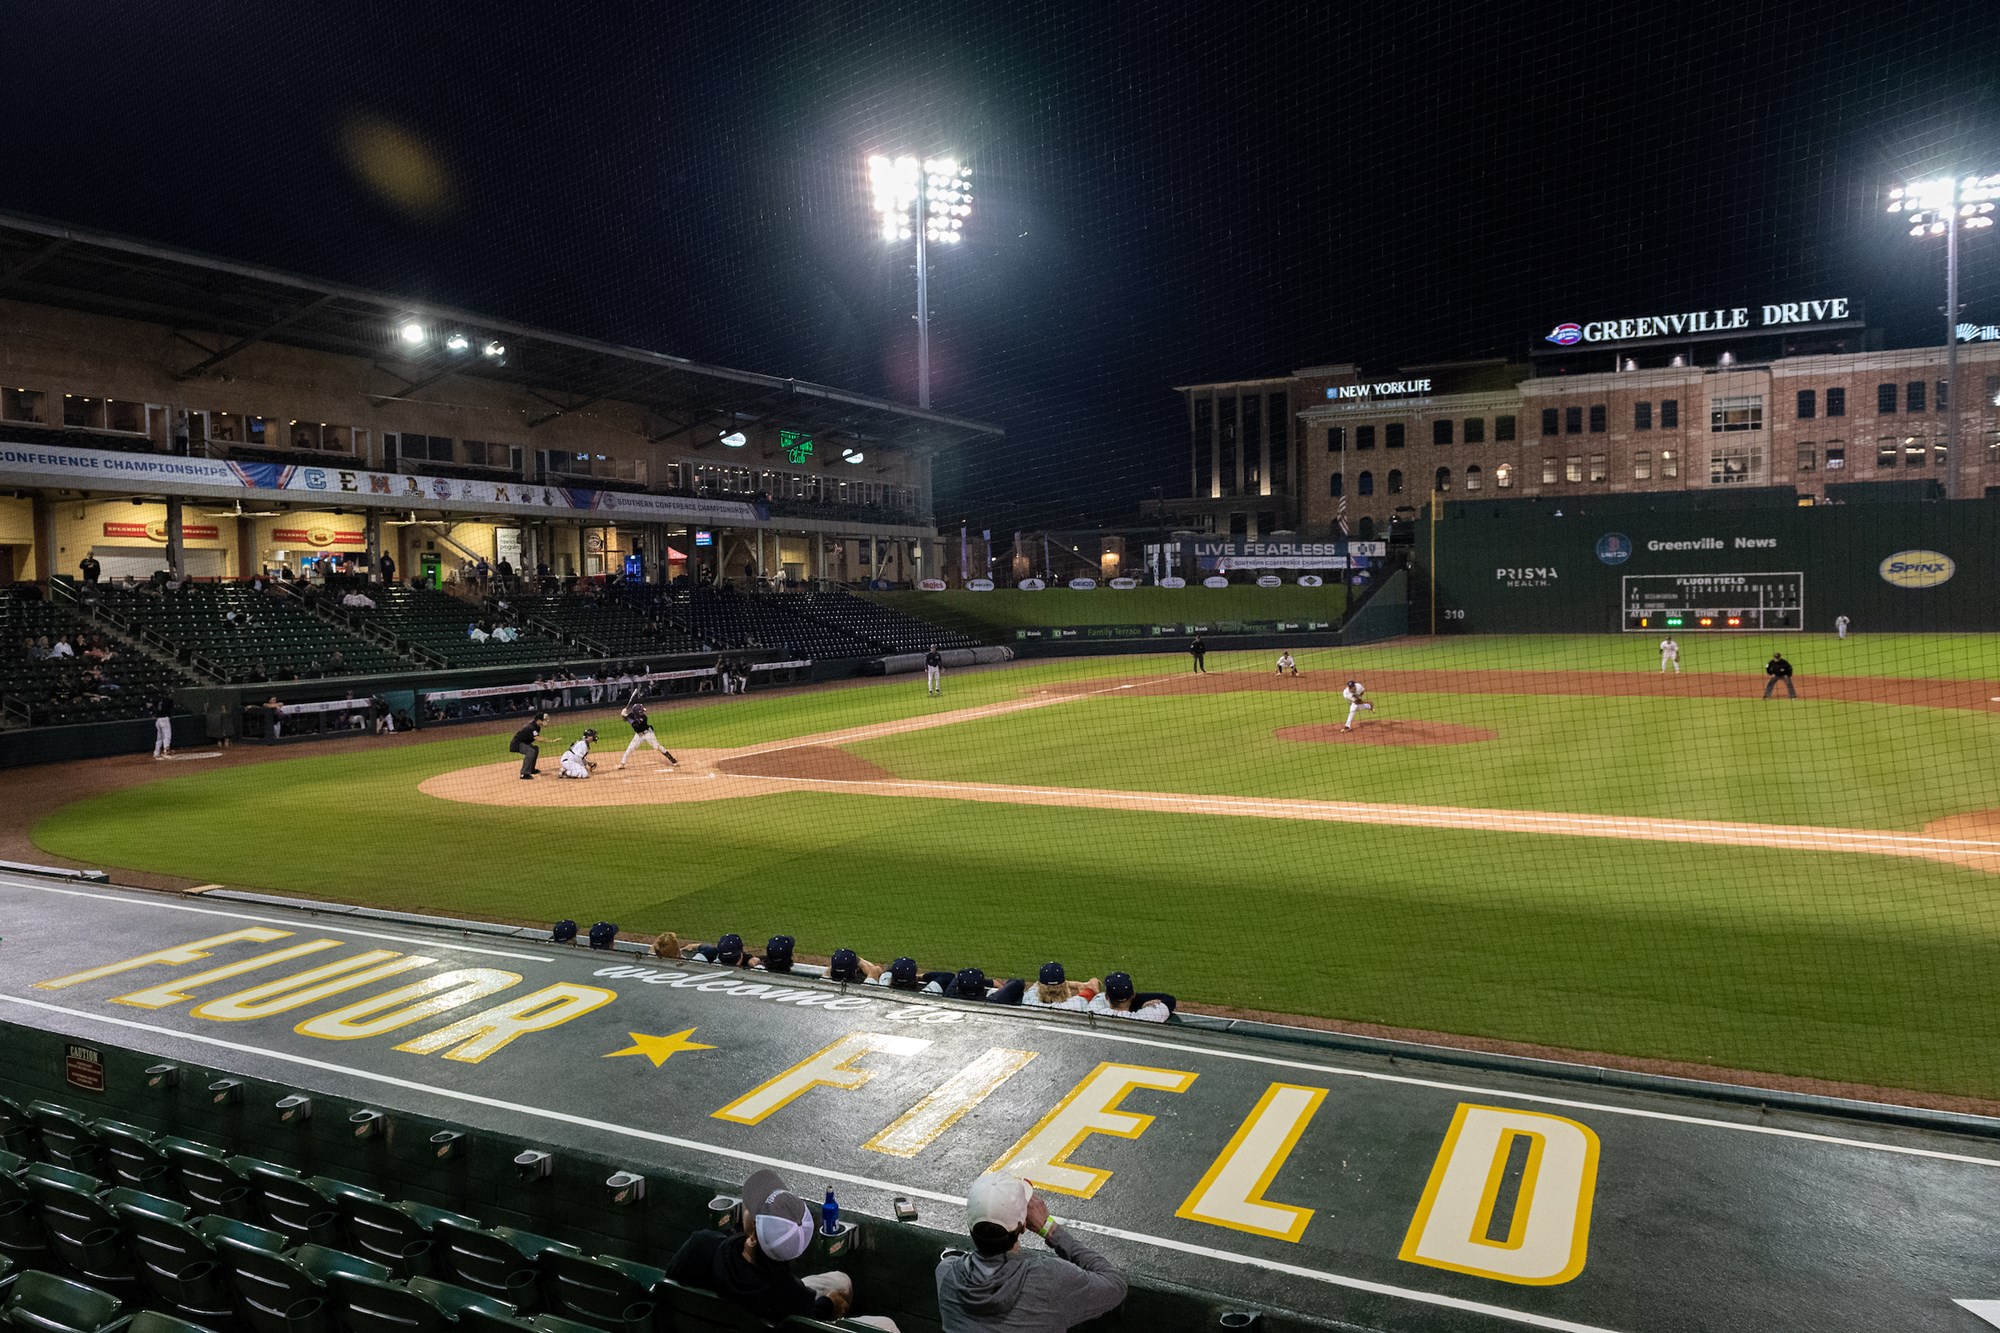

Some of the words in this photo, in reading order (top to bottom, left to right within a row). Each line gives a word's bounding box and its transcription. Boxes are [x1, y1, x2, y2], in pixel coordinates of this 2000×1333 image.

[1583, 308, 1749, 342] GREENVILLE
[1762, 298, 1849, 326] DRIVE
[1339, 385, 1370, 398] NEW
[1373, 382, 1406, 395] YORK
[1407, 379, 1431, 392] LIFE
[104, 459, 227, 477] CHAMPIONSHIPS
[617, 498, 653, 508] SOUTHERN
[655, 501, 696, 511] CONFERENCE
[697, 503, 750, 514] CHAMPIONSHIPS
[1195, 543, 1236, 556] LIVE
[1243, 543, 1336, 556] FEARLESS
[1648, 537, 1724, 551] Greenville
[1735, 536, 1778, 549] News
[1497, 567, 1559, 580] PRISMA
[1676, 578, 1712, 586] FLUOR
[1714, 577, 1746, 585] FIELD
[1445, 609, 1465, 619] 310
[1088, 628, 1113, 637] Family
[1217, 625, 1241, 633] Family
[593, 964, 873, 1010] welcome
[885, 1005, 966, 1024] to
[70, 1045, 98, 1062] CAUTION
[30, 926, 617, 1064] FLUOR
[711, 1032, 1601, 1286] FIELD
